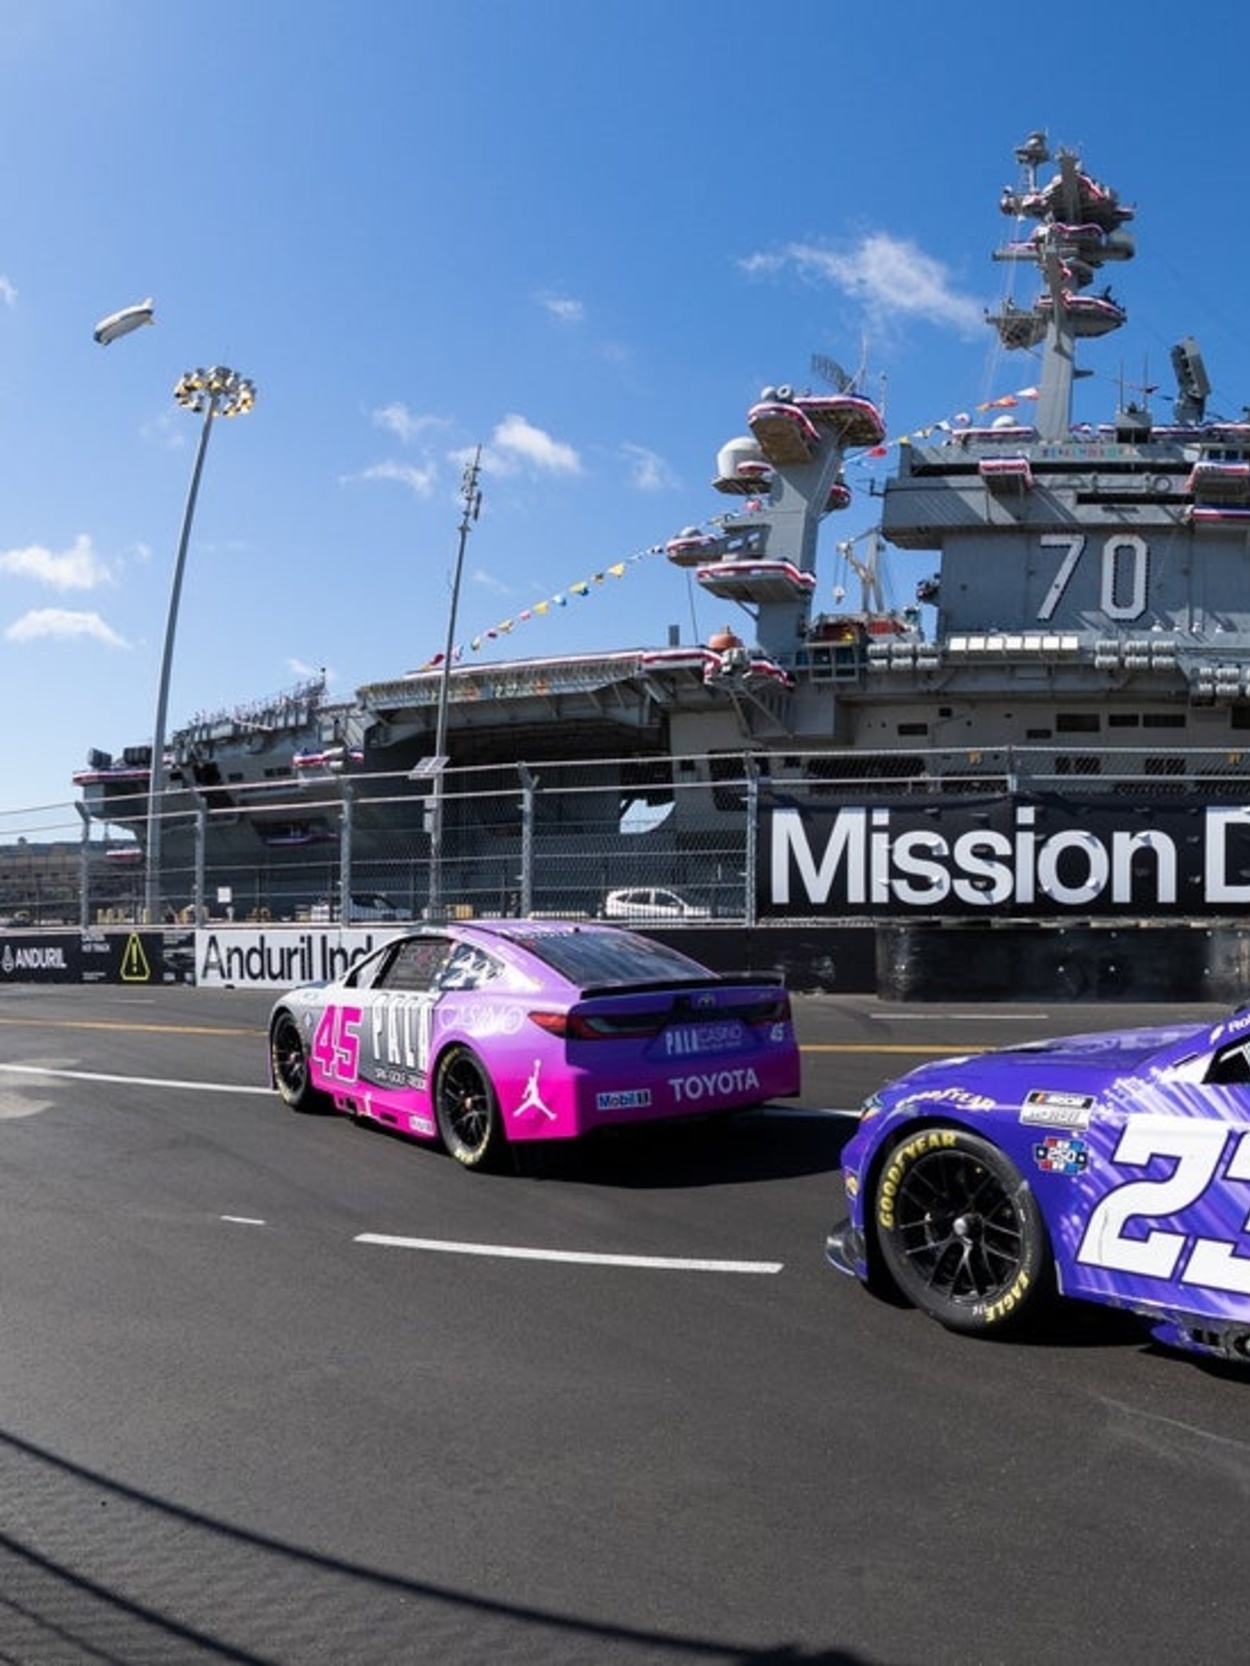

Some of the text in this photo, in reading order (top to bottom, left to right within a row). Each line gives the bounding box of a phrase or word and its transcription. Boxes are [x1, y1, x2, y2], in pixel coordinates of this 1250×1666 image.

[1037, 534, 1149, 622] 70
[771, 806, 1178, 905] Mission
[15, 947, 68, 969] ANDURIL
[202, 934, 314, 981] Anduril
[312, 1003, 365, 1083] 45
[667, 1067, 761, 1102] TOYOTA
[878, 1131, 957, 1230] GOODYEAR
[984, 1270, 1030, 1323] EAGLE
